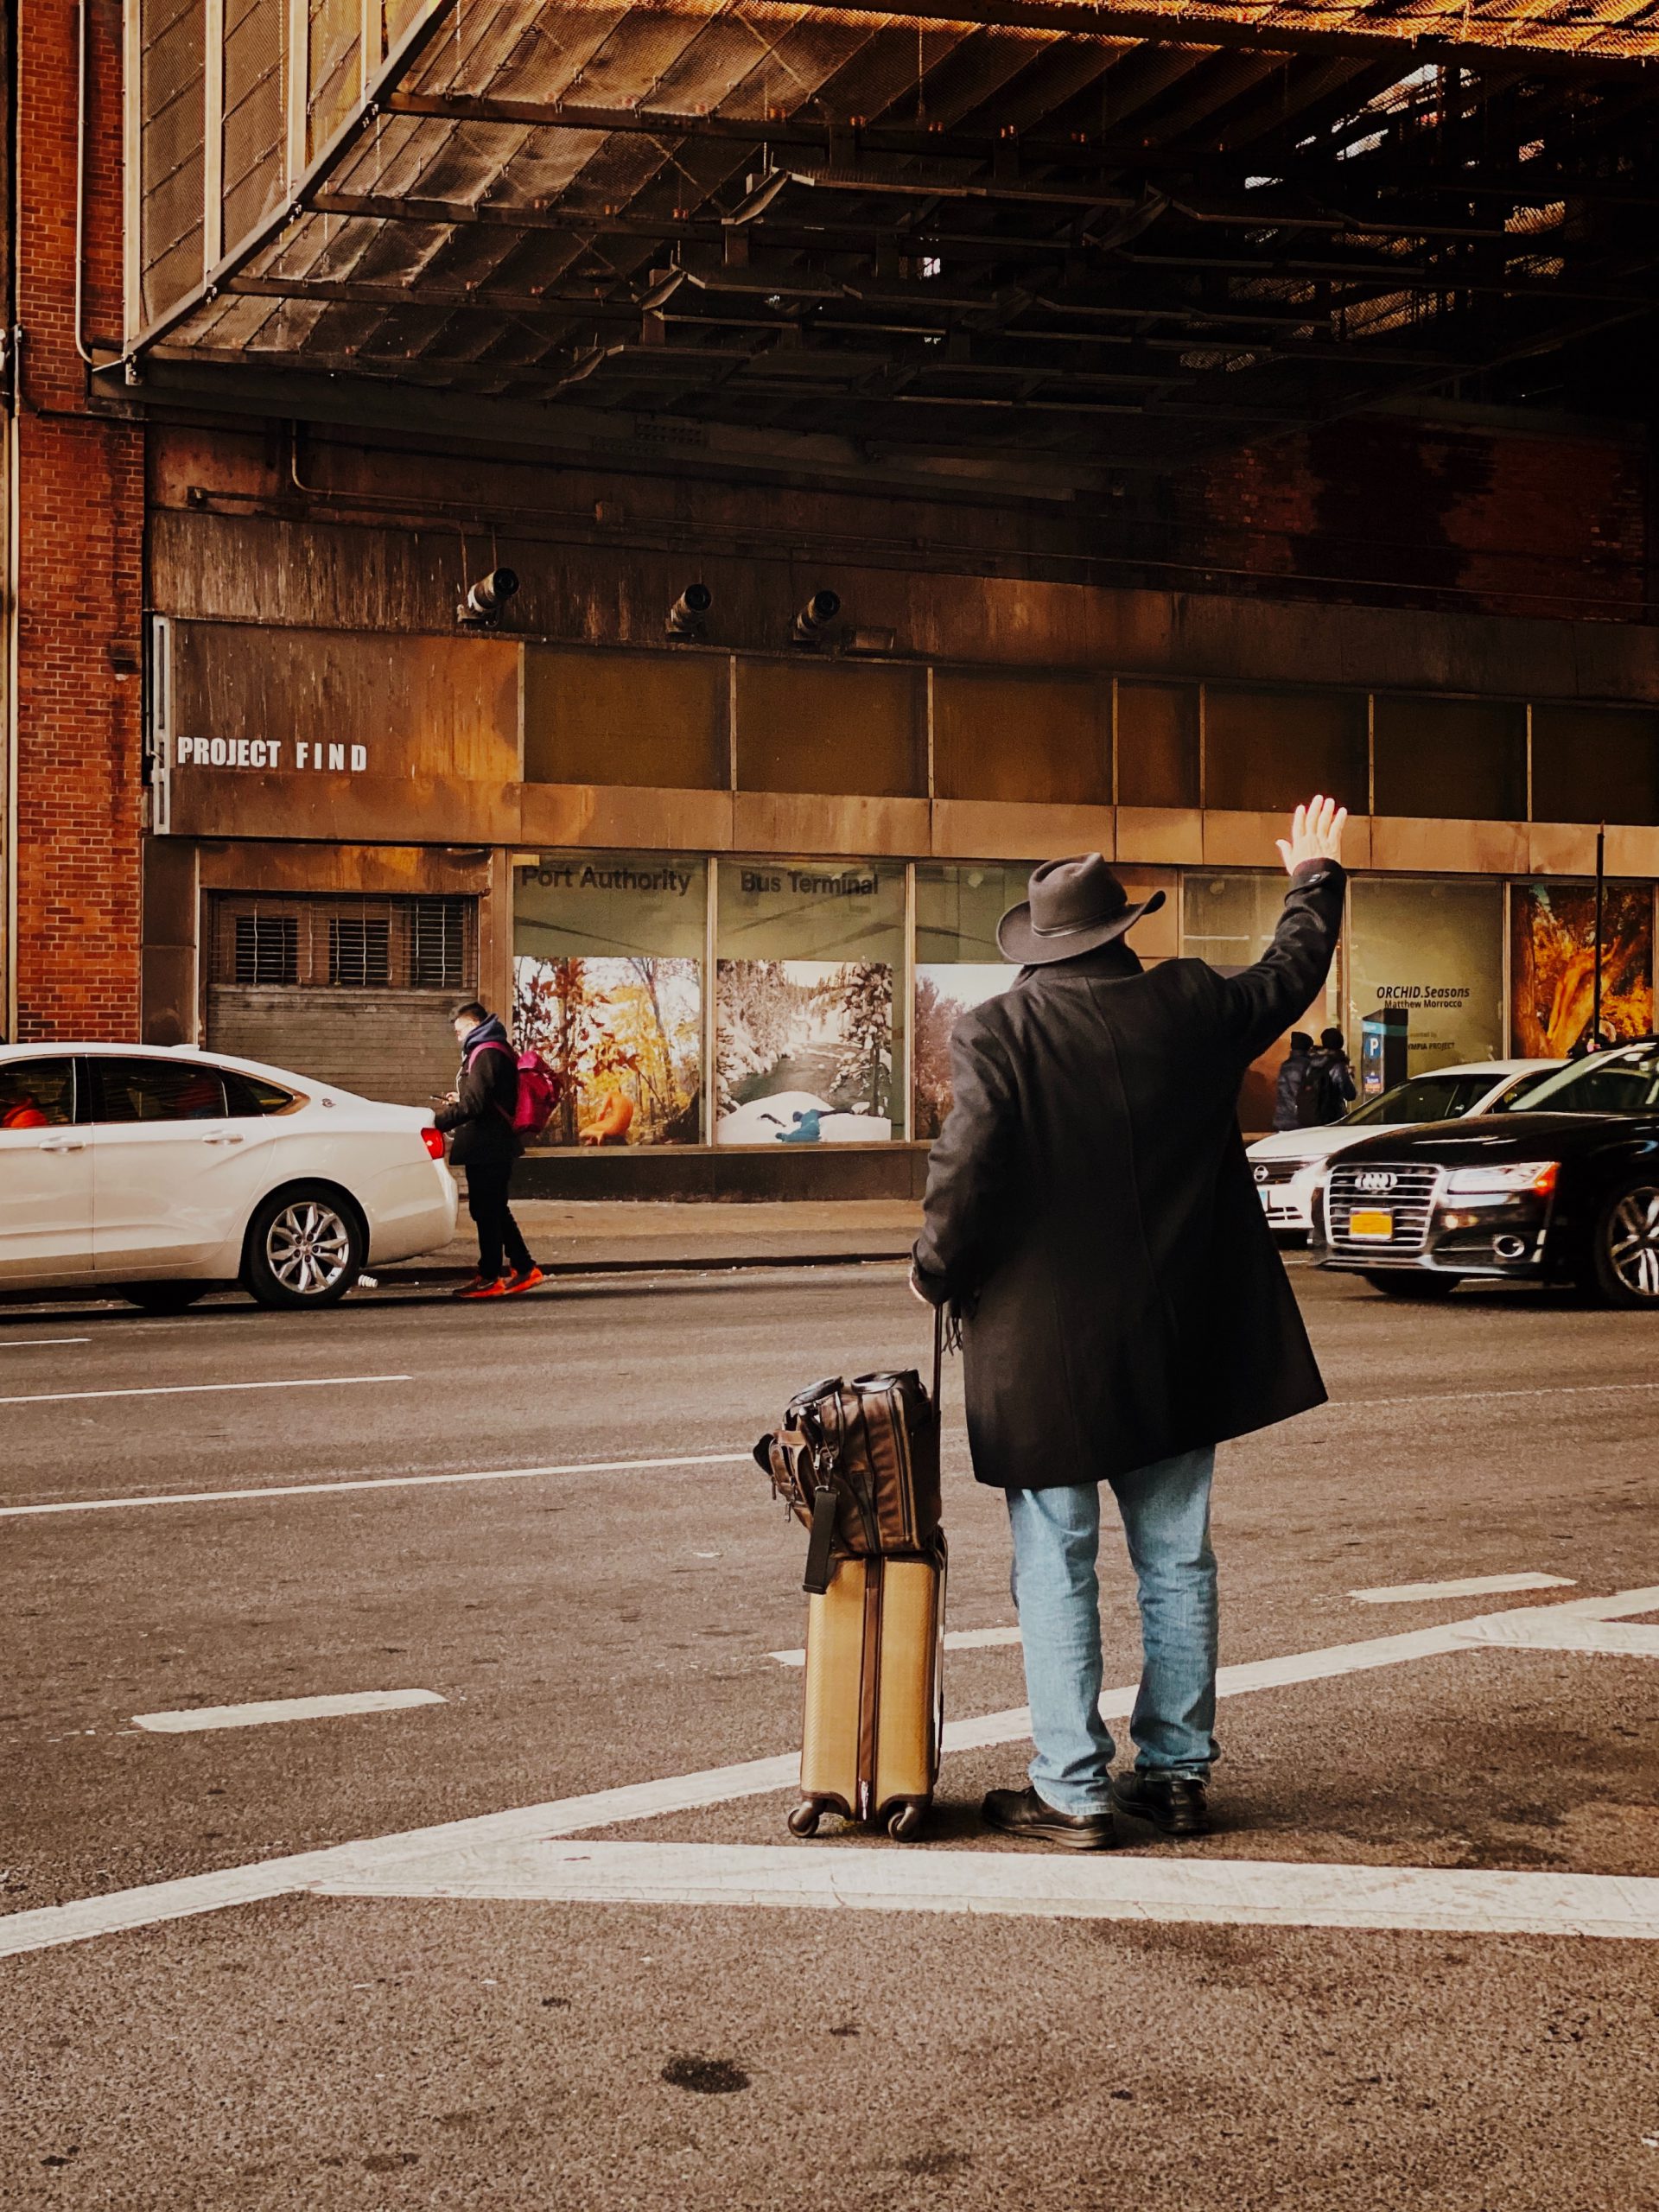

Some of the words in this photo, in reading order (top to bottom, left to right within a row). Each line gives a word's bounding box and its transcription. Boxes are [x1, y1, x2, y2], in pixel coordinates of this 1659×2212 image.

[177, 736, 281, 767] PROJECT
[296, 742, 367, 772] FIND
[521, 867, 574, 889] Port
[580, 867, 691, 895] Authority
[741, 871, 782, 893] Bus
[787, 872, 879, 895] Terminal
[1376, 986, 1470, 999] ORCHID.Seasons
[1384, 1000, 1421, 1008] Matthew
[1370, 1038, 1378, 1056] P
[1428, 1042, 1455, 1051] PROJECT
